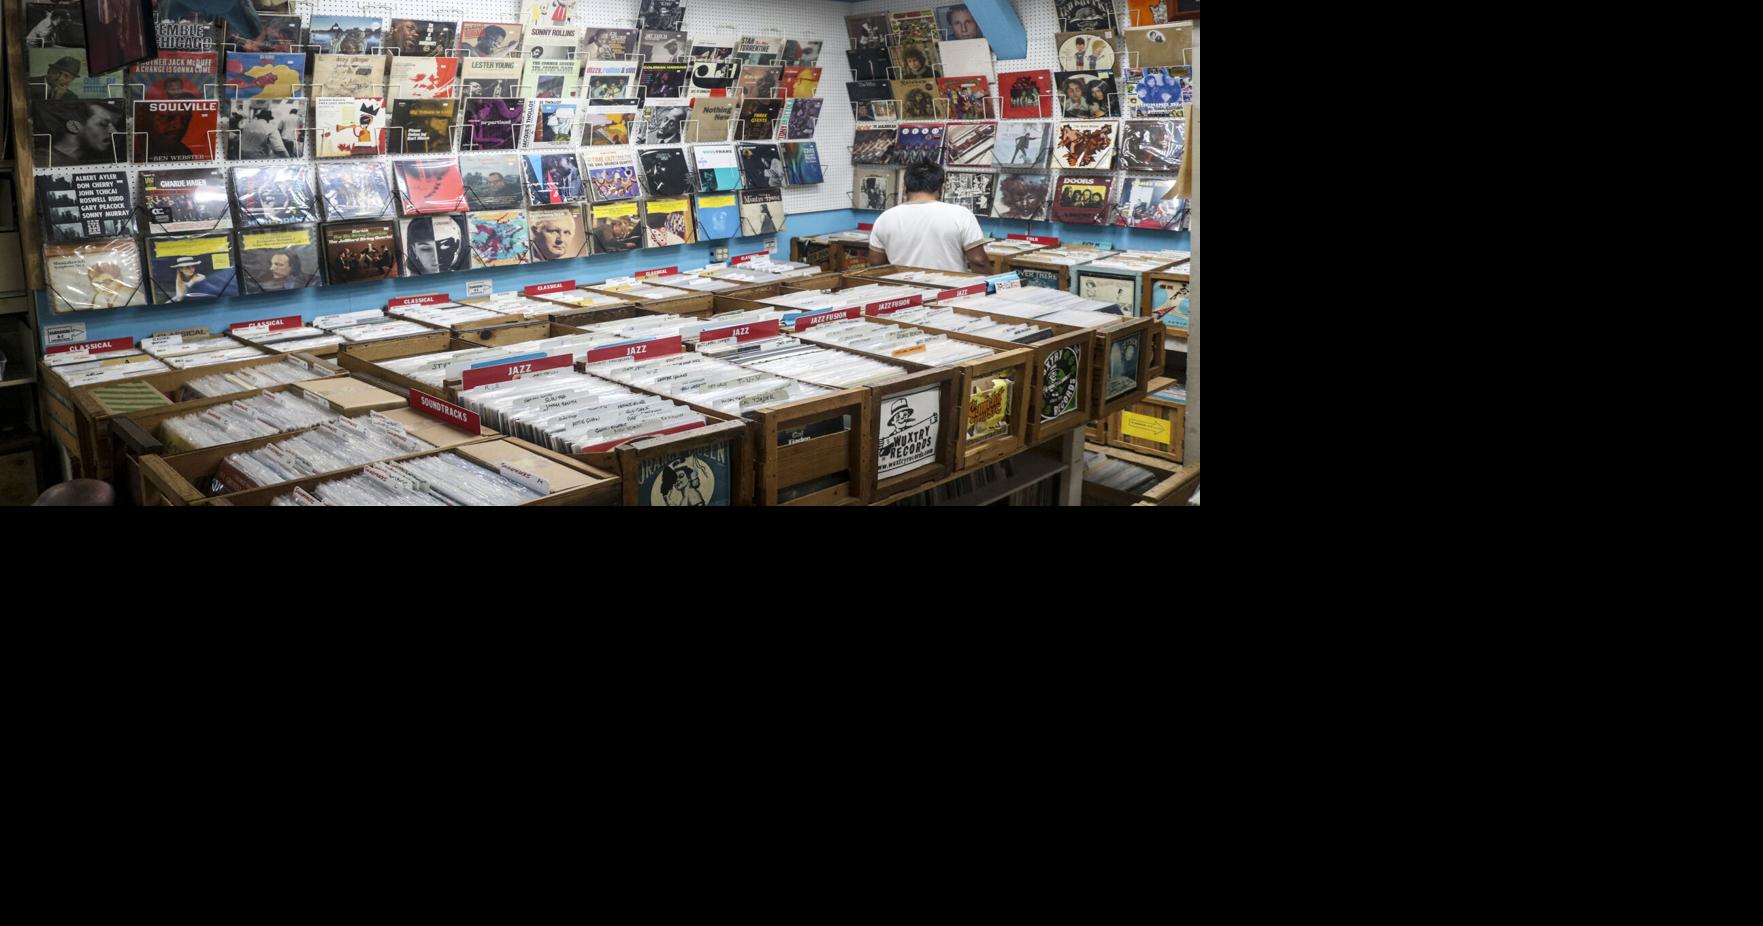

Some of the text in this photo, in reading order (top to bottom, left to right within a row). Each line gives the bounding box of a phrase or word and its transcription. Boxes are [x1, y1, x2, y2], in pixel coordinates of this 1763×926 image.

[531, 28, 575, 37] SONNY ROLLINS
[741, 37, 755, 45] STAN
[149, 102, 217, 111] SOULVILLE
[703, 106, 732, 114] Nothing
[537, 283, 563, 291] CLASSICAL
[403, 296, 434, 305] CLASSICAL
[878, 299, 911, 310] JAZZ FUSION
[811, 312, 848, 324] JAZZ FUSION
[248, 319, 285, 329] CLASSICAL
[731, 327, 750, 337] JAZZ
[69, 341, 112, 352] CLASSICAL
[626, 344, 648, 356] JAZZ
[507, 364, 533, 376] JAZZ
[420, 396, 468, 423] SOUNDTRACKS
[893, 425, 930, 448] WUXTRY
[889, 436, 932, 459] RECORDS
